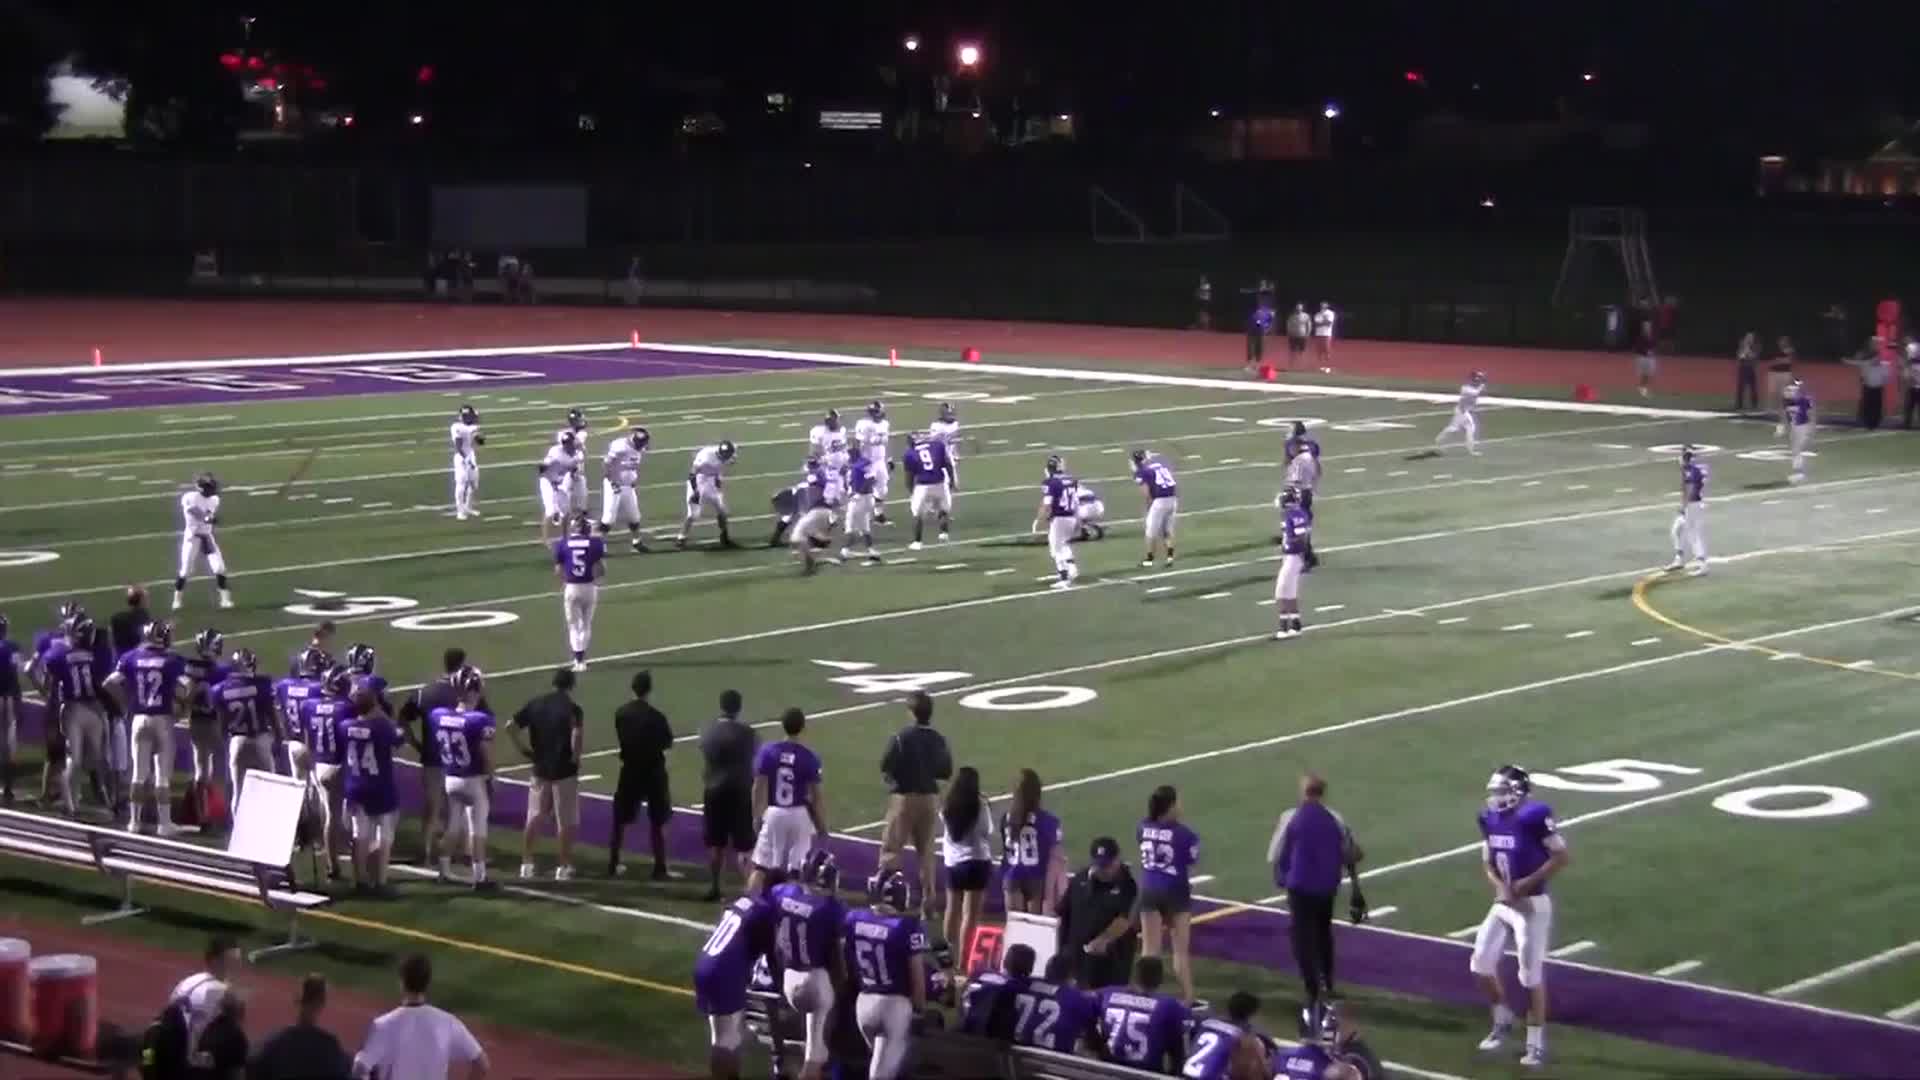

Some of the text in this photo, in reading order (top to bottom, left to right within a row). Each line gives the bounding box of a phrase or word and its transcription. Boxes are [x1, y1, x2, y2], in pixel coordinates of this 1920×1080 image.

[919, 448, 934, 471] 9
[571, 549, 586, 577] 5
[71, 663, 95, 697] 11
[137, 669, 163, 707] 12
[828, 671, 1098, 710] 40
[227, 698, 260, 736] 21
[435, 729, 471, 767] 33
[775, 767, 795, 806] 6
[1529, 758, 1869, 819] 50
[702, 909, 743, 957] 10
[775, 915, 811, 966] 41
[909, 932, 925, 950] 51
[855, 939, 893, 985] 51
[1015, 993, 1061, 1049] 72
[1105, 1007, 1151, 1061] 75
[1182, 1032, 1219, 1078] 2
